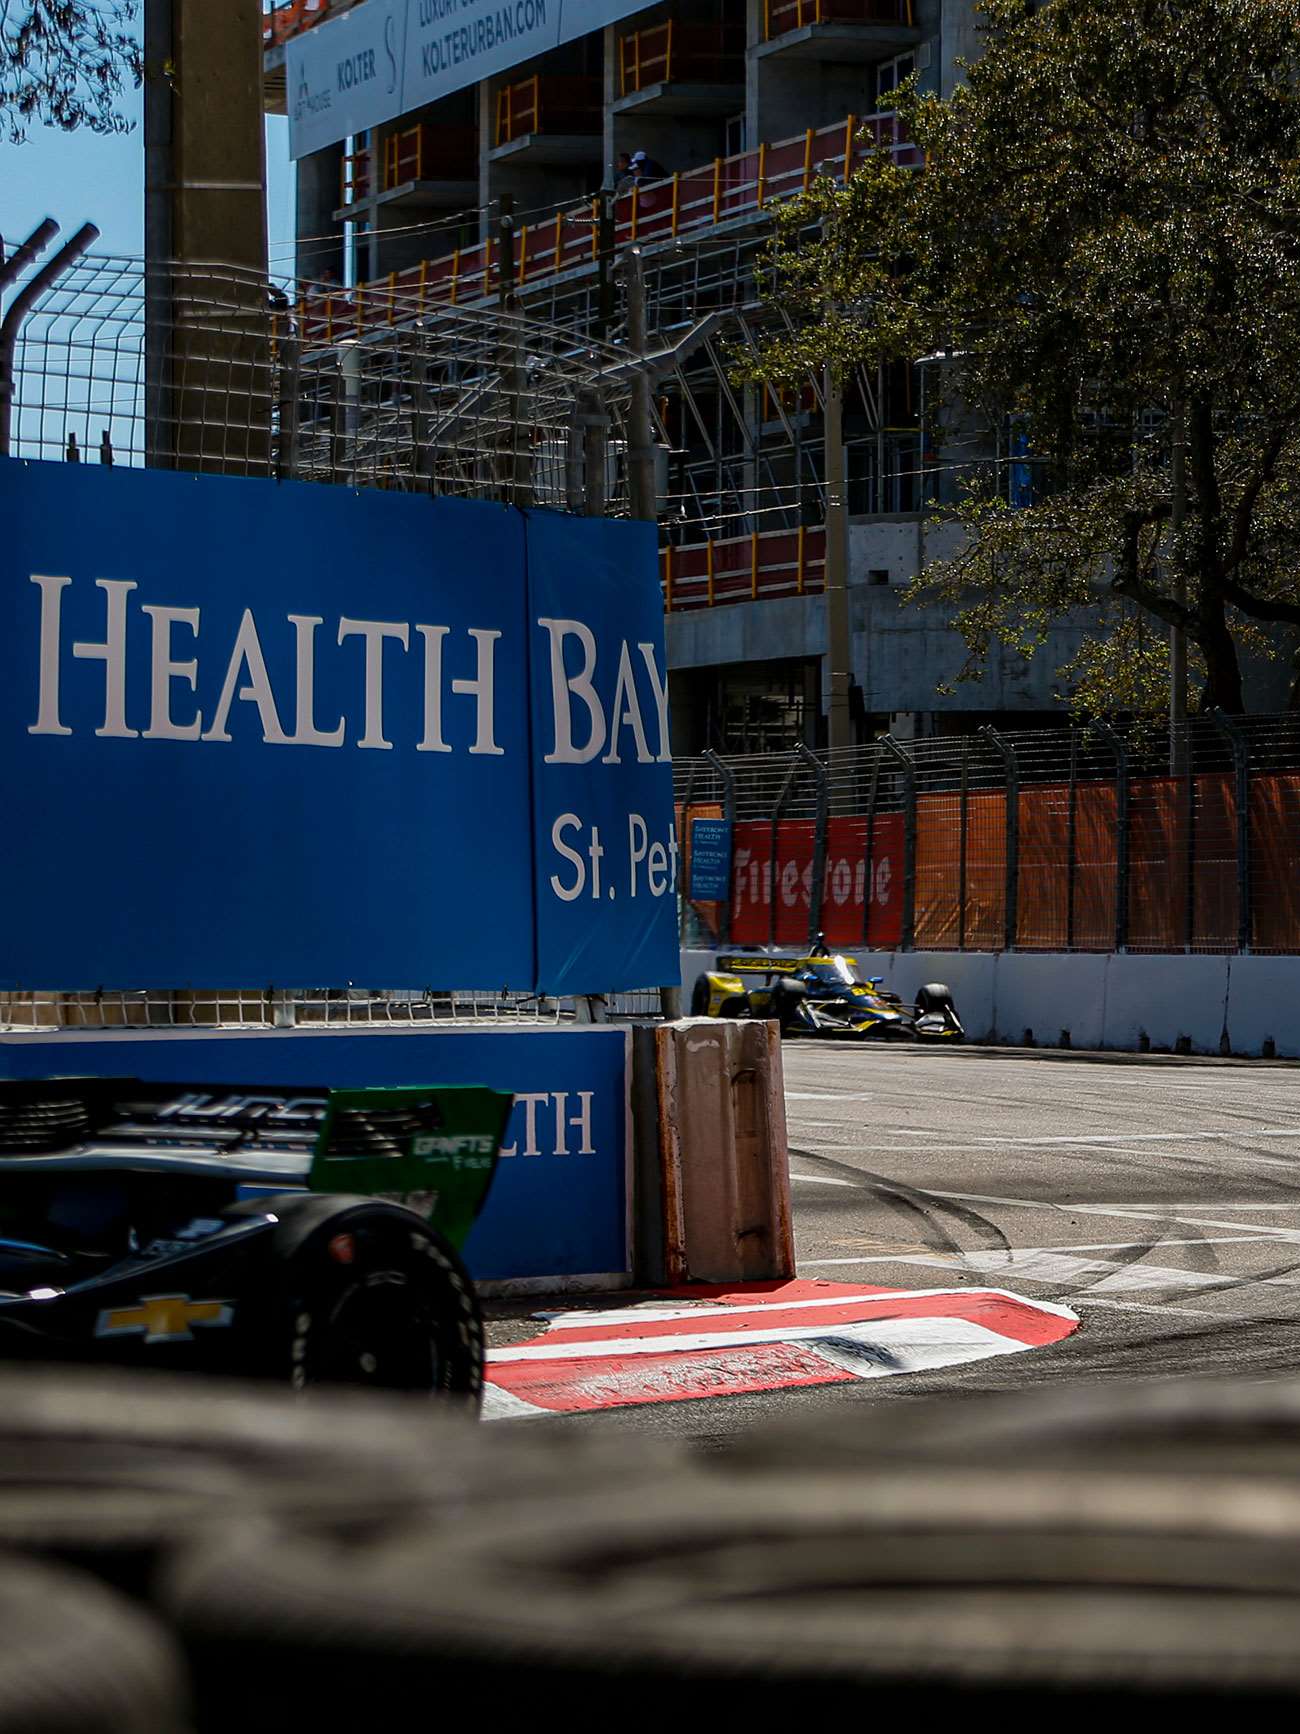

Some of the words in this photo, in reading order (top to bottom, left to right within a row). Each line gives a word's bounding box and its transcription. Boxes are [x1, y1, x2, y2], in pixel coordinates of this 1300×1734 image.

[337, 48, 377, 92] KOLTER
[422, 3, 546, 77] KOLTERURBAN.COM
[28, 574, 504, 756] HEALTH
[549, 813, 616, 901] St.
